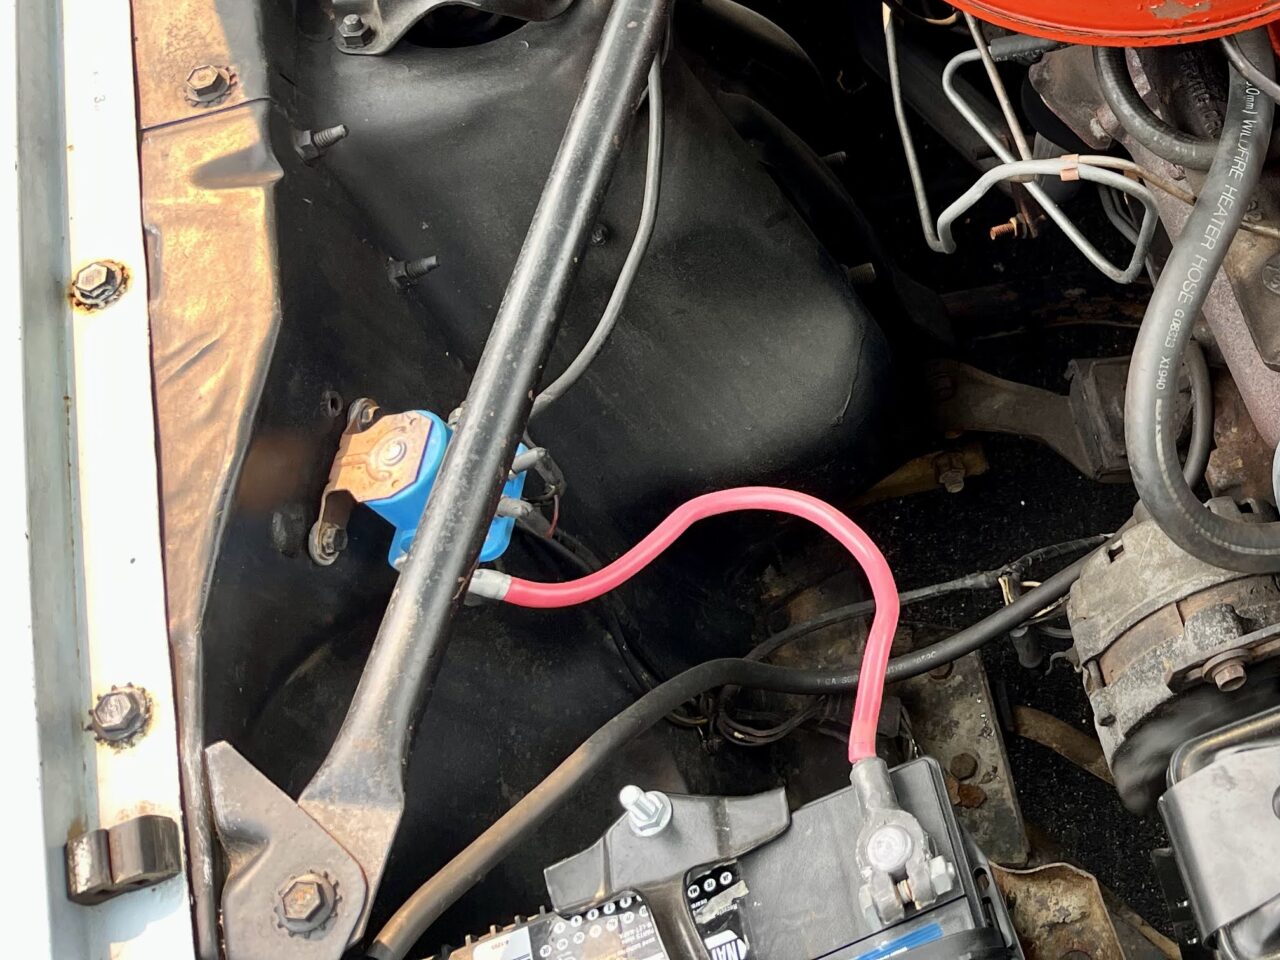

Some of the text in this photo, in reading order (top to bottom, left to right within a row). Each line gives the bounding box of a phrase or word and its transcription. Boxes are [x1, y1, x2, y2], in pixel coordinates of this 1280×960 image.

[1229, 119, 1257, 182] WILDFIRE
[1200, 183, 1238, 251] HEATER
[1177, 253, 1208, 305] HOSE
[1155, 355, 1171, 390] X1940
